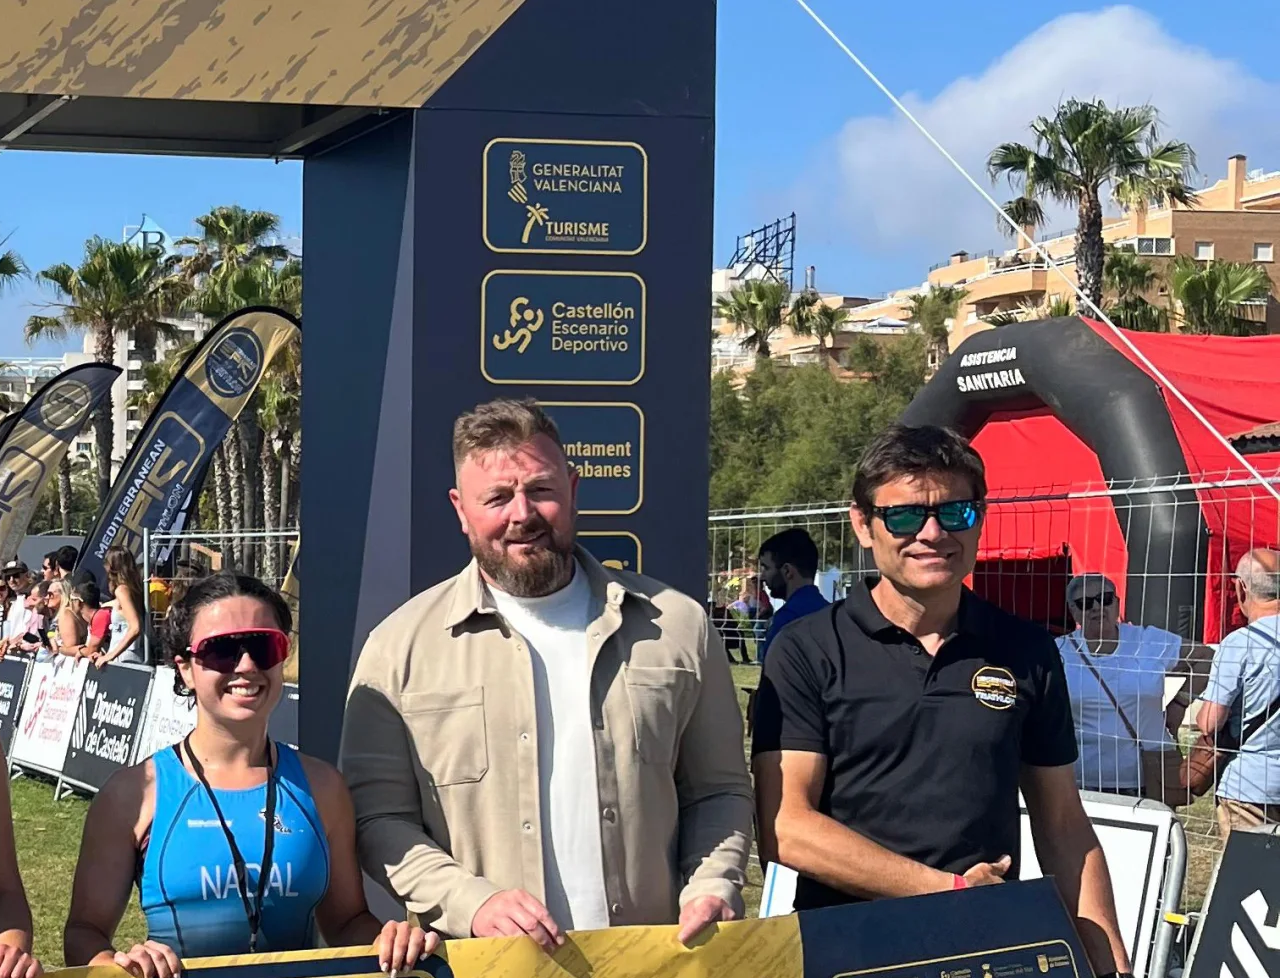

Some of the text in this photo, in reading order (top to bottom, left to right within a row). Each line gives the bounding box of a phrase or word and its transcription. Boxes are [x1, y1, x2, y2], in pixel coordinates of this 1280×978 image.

[532, 163, 624, 178] GENERALITAT
[534, 179, 622, 193] VALENCIANA
[545, 221, 609, 236] TURISME
[552, 302, 635, 319] Castellón
[552, 321, 629, 336] Escenario
[552, 337, 629, 354] Deportivo
[960, 347, 1016, 368] ASISTENCIA
[957, 368, 1025, 392] SANITARIA
[563, 442, 632, 457] ntament
[95, 438, 167, 560] MEDITERRANEAN
[92, 692, 136, 729] Diputació
[85, 728, 131, 765] de Castelló
